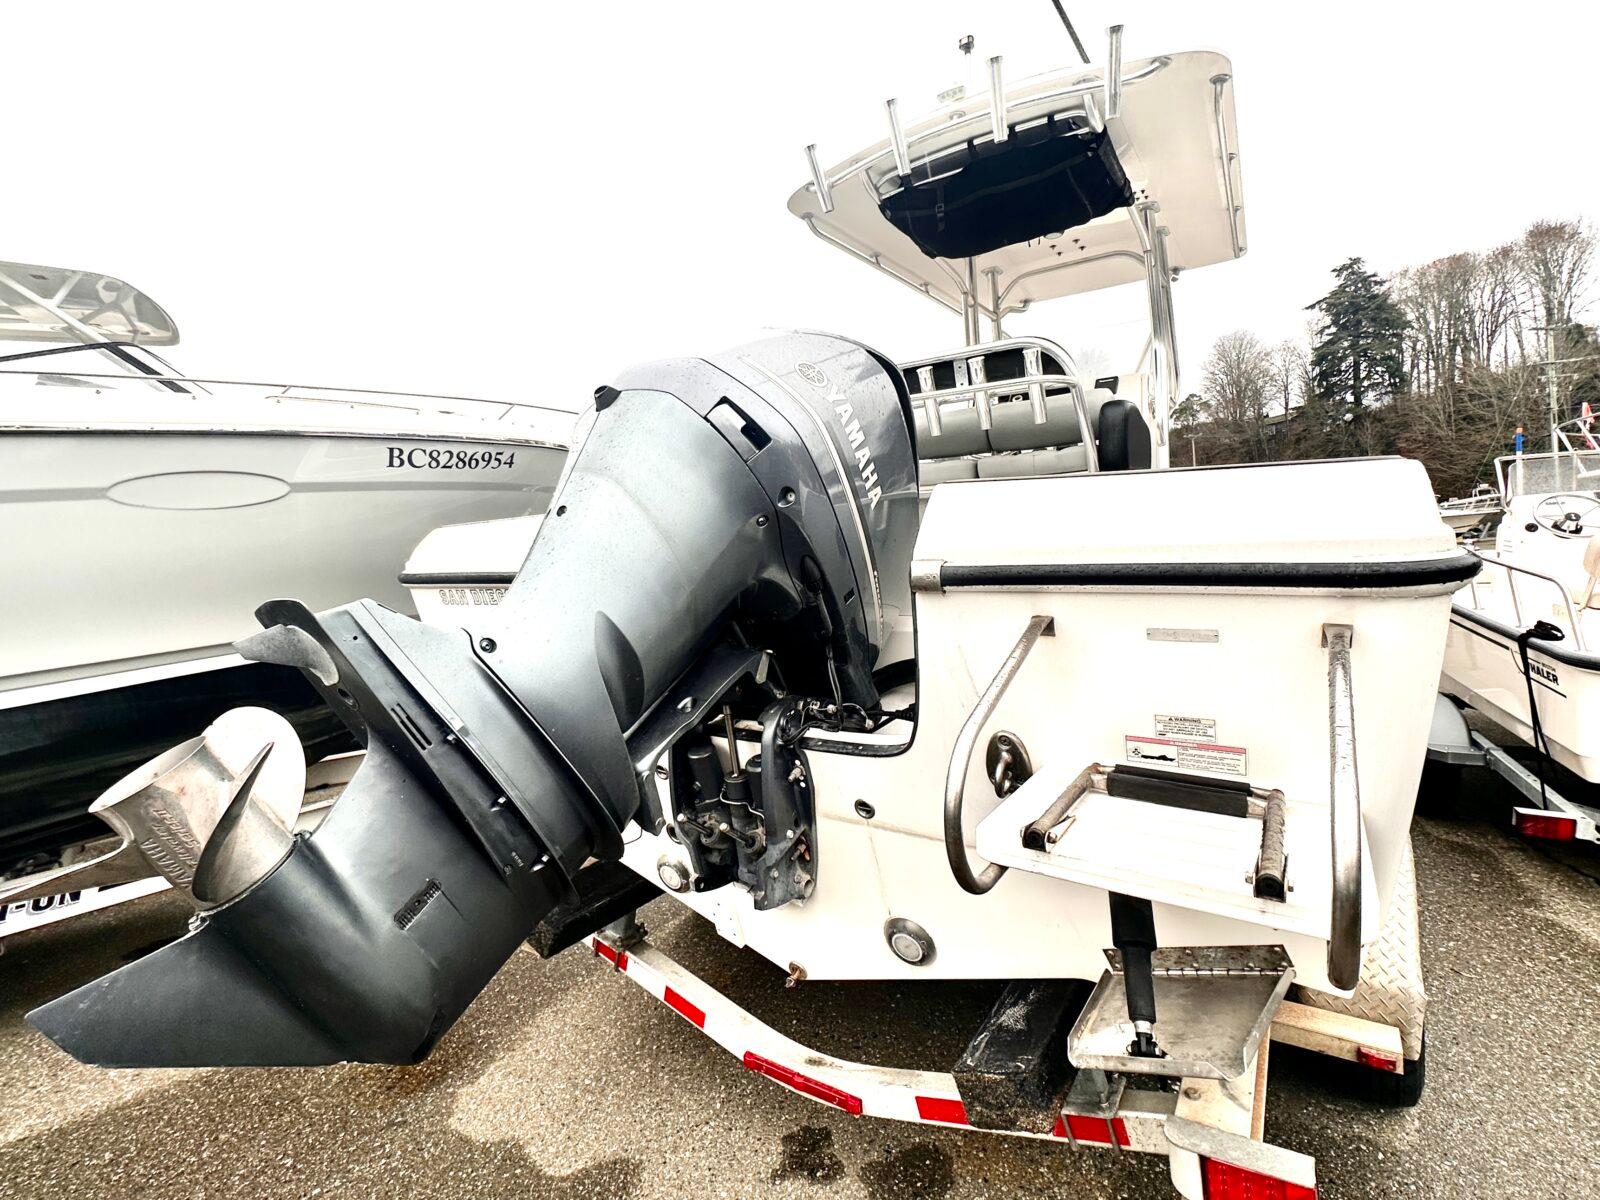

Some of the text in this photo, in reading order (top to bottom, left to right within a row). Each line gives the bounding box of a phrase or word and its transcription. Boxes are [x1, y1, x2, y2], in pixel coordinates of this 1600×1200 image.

[386, 446, 515, 470] BC8286954
[825, 384, 882, 511] YAMAHA
[439, 588, 508, 606] SAN DIEG
[1528, 661, 1559, 686] HALER
[141, 838, 194, 890] YAMAHA
